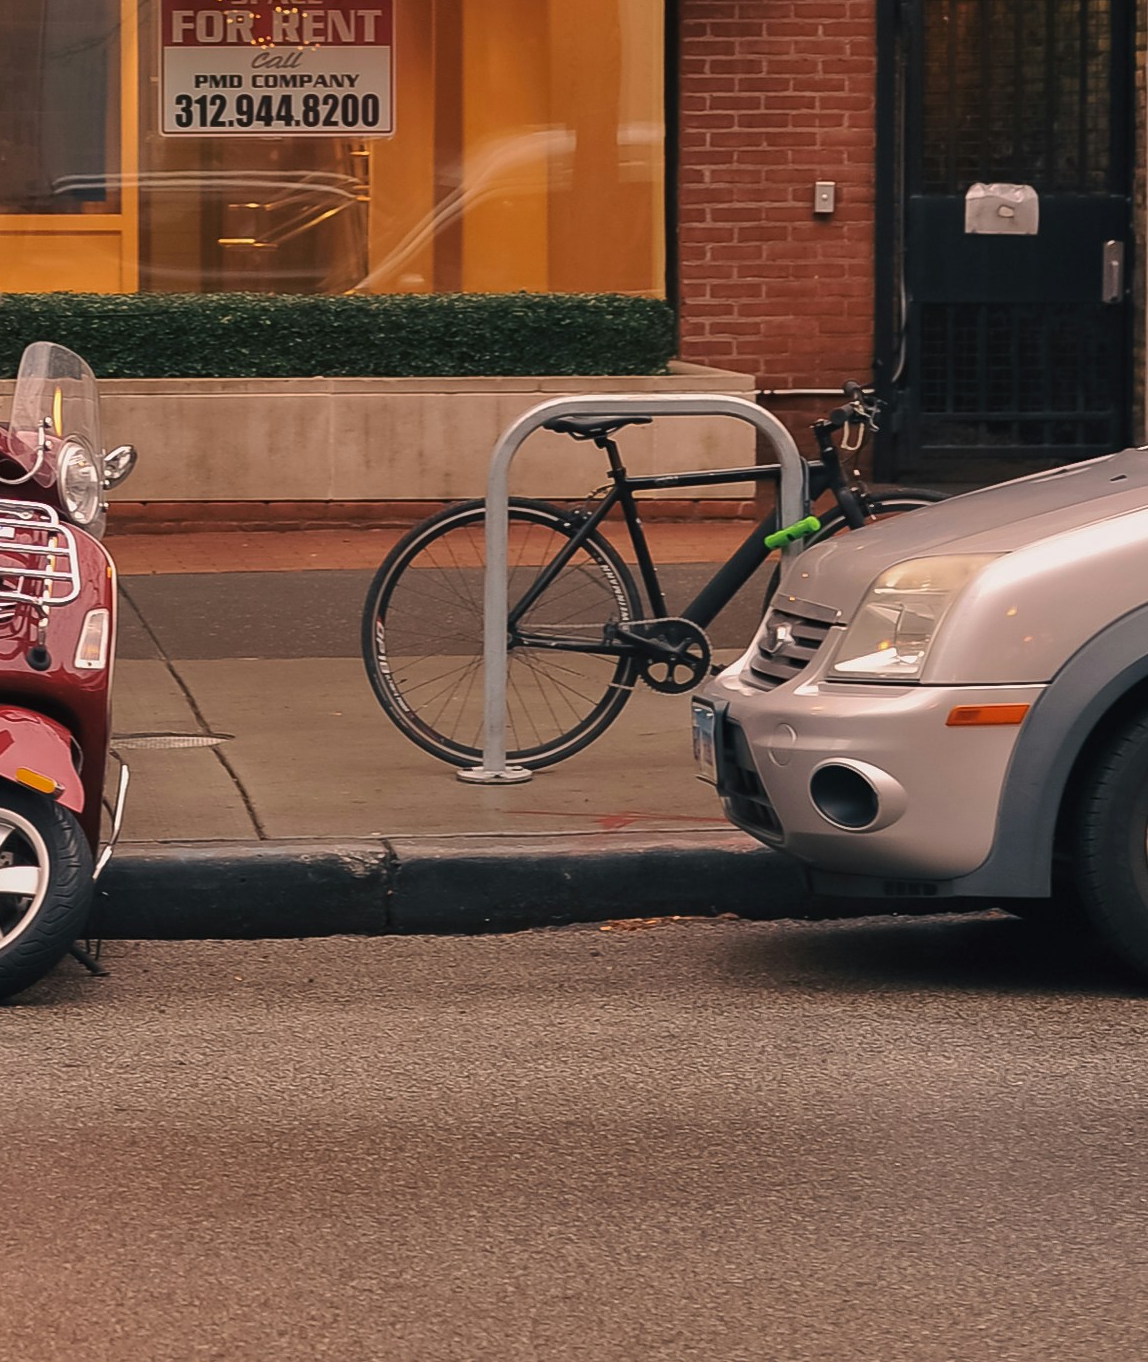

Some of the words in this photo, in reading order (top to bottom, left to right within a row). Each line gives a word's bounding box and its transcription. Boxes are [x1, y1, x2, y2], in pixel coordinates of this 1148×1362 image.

[171, 10, 256, 43] FOR
[272, 10, 382, 43] RENT
[252, 52, 304, 69] Call
[194, 74, 243, 89] PMD
[252, 74, 360, 89] COMPANY
[175, 93, 380, 128] 312.944.8200
